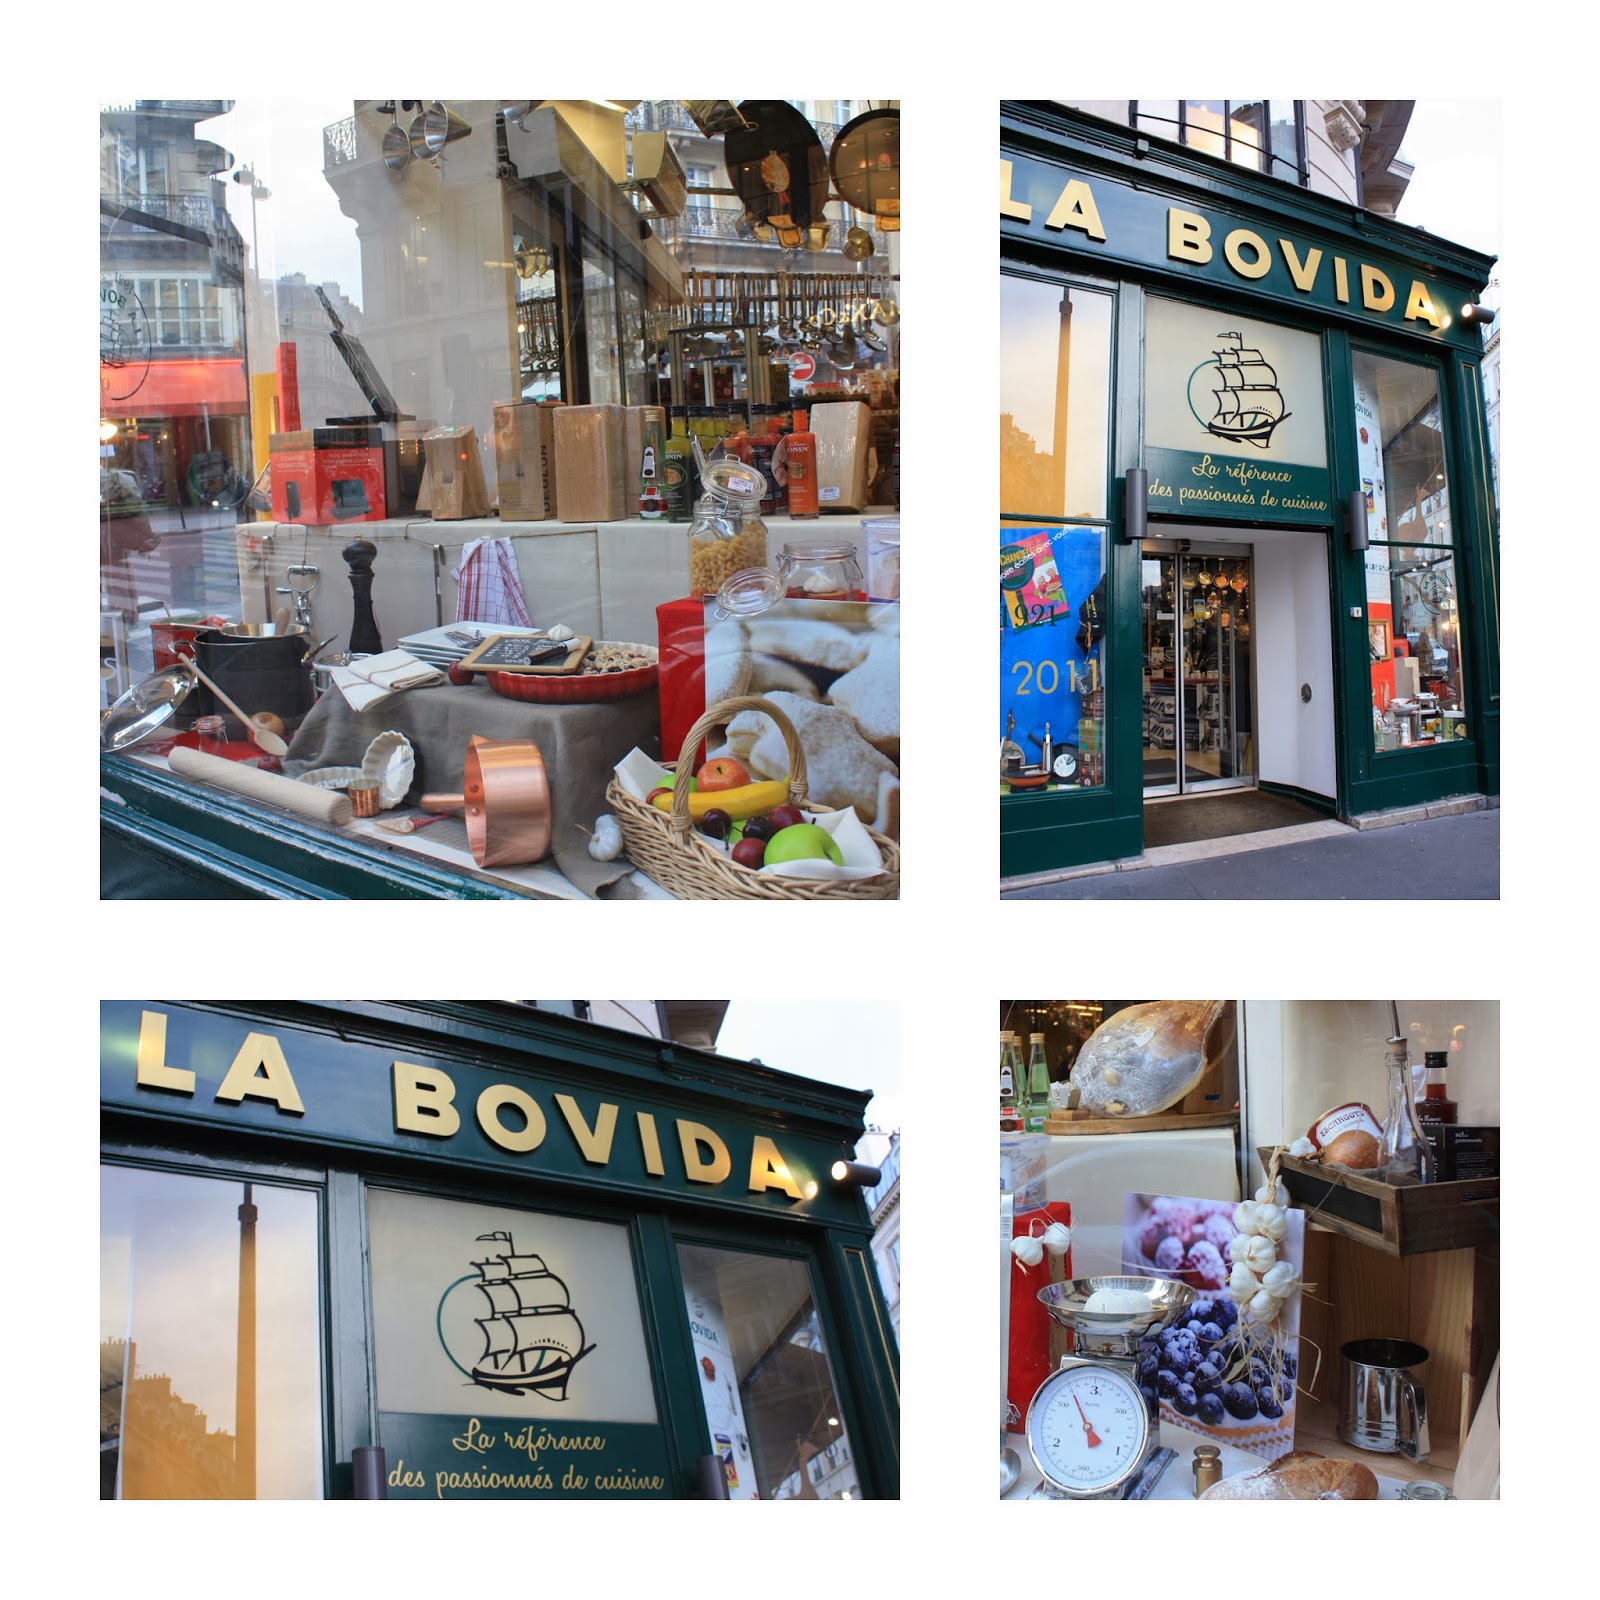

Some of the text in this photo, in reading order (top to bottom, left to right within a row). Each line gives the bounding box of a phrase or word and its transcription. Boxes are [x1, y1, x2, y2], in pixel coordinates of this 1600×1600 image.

[1000, 159, 1441, 329] LA BOVIDA
[1192, 455, 1293, 487] La référence
[1149, 479, 1328, 511] des passionnés de cuisine
[1036, 539, 1054, 554] avec
[1000, 603, 1056, 629] 1921
[1011, 659, 1098, 695] 2011
[137, 1010, 803, 1201] LA BOVIDA
[1090, 1386, 1098, 1395] 3
[452, 1418, 606, 1461] La référence
[1053, 1438, 1060, 1447] 2
[388, 1460, 664, 1499] des passionnés de cuisine
